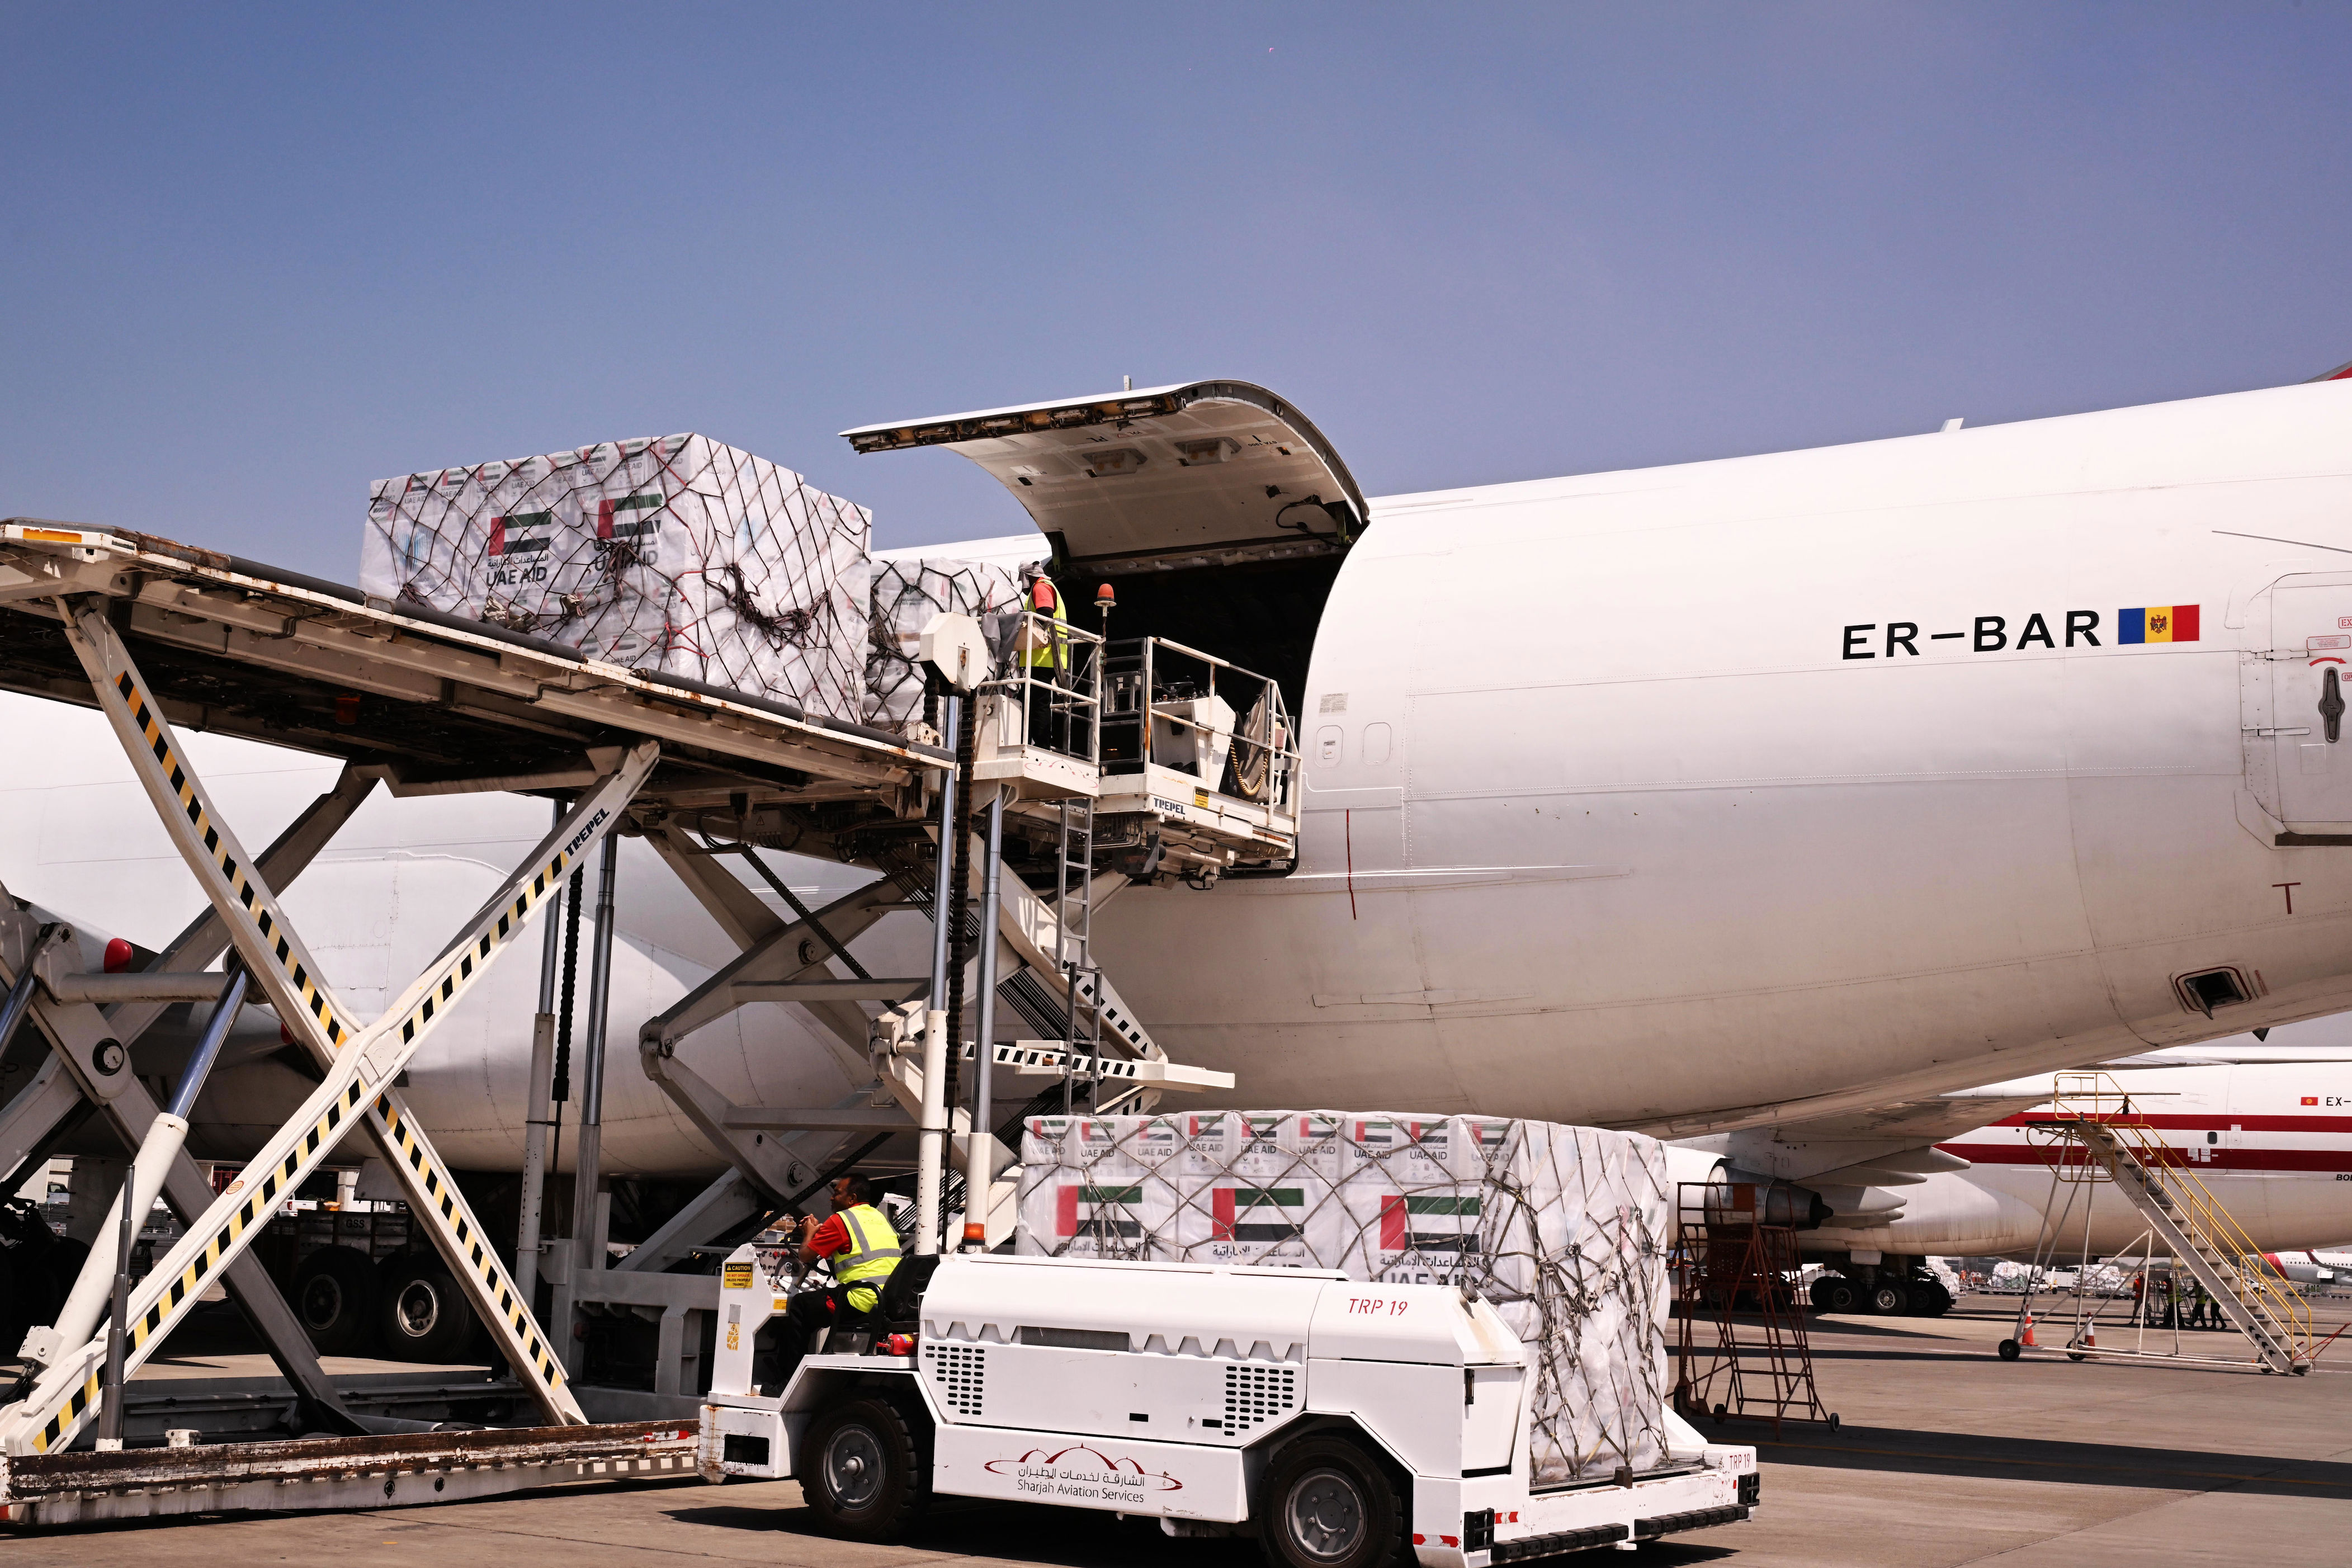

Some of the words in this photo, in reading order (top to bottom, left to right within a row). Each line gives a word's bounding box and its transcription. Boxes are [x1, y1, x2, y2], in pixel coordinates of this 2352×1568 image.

[486, 569, 517, 587] UAE
[519, 566, 547, 584] AID
[1154, 797, 1186, 815] TREPEL
[564, 807, 610, 856] TREPEL
[1081, 1149, 1098, 1158] UAE
[1137, 1148, 1155, 1156] UAE
[1157, 1148, 1172, 1156] AID
[1189, 1144, 1206, 1152] UAE
[1208, 1144, 1224, 1152] AID
[1260, 1145, 1277, 1154] AID
[1319, 1146, 1335, 1154] AID
[1354, 1150, 1373, 1158] UAE
[1432, 1151, 1447, 1160] AID
[346, 1219, 365, 1229] GSS
[1349, 1298, 1383, 1314] TRP
[1390, 1301, 1408, 1316] 19
[1729, 1454, 1742, 1470] TRP
[1744, 1453, 1750, 1468] 19
[1018, 1465, 1056, 1480] الطيران
[1060, 1468, 1099, 1482] لخدمات
[1103, 1473, 1145, 1487] الشارقة
[1017, 1479, 1054, 1495] Sharjah
[1057, 1483, 1099, 1499] Aviation
[1102, 1488, 1144, 1503] Services
